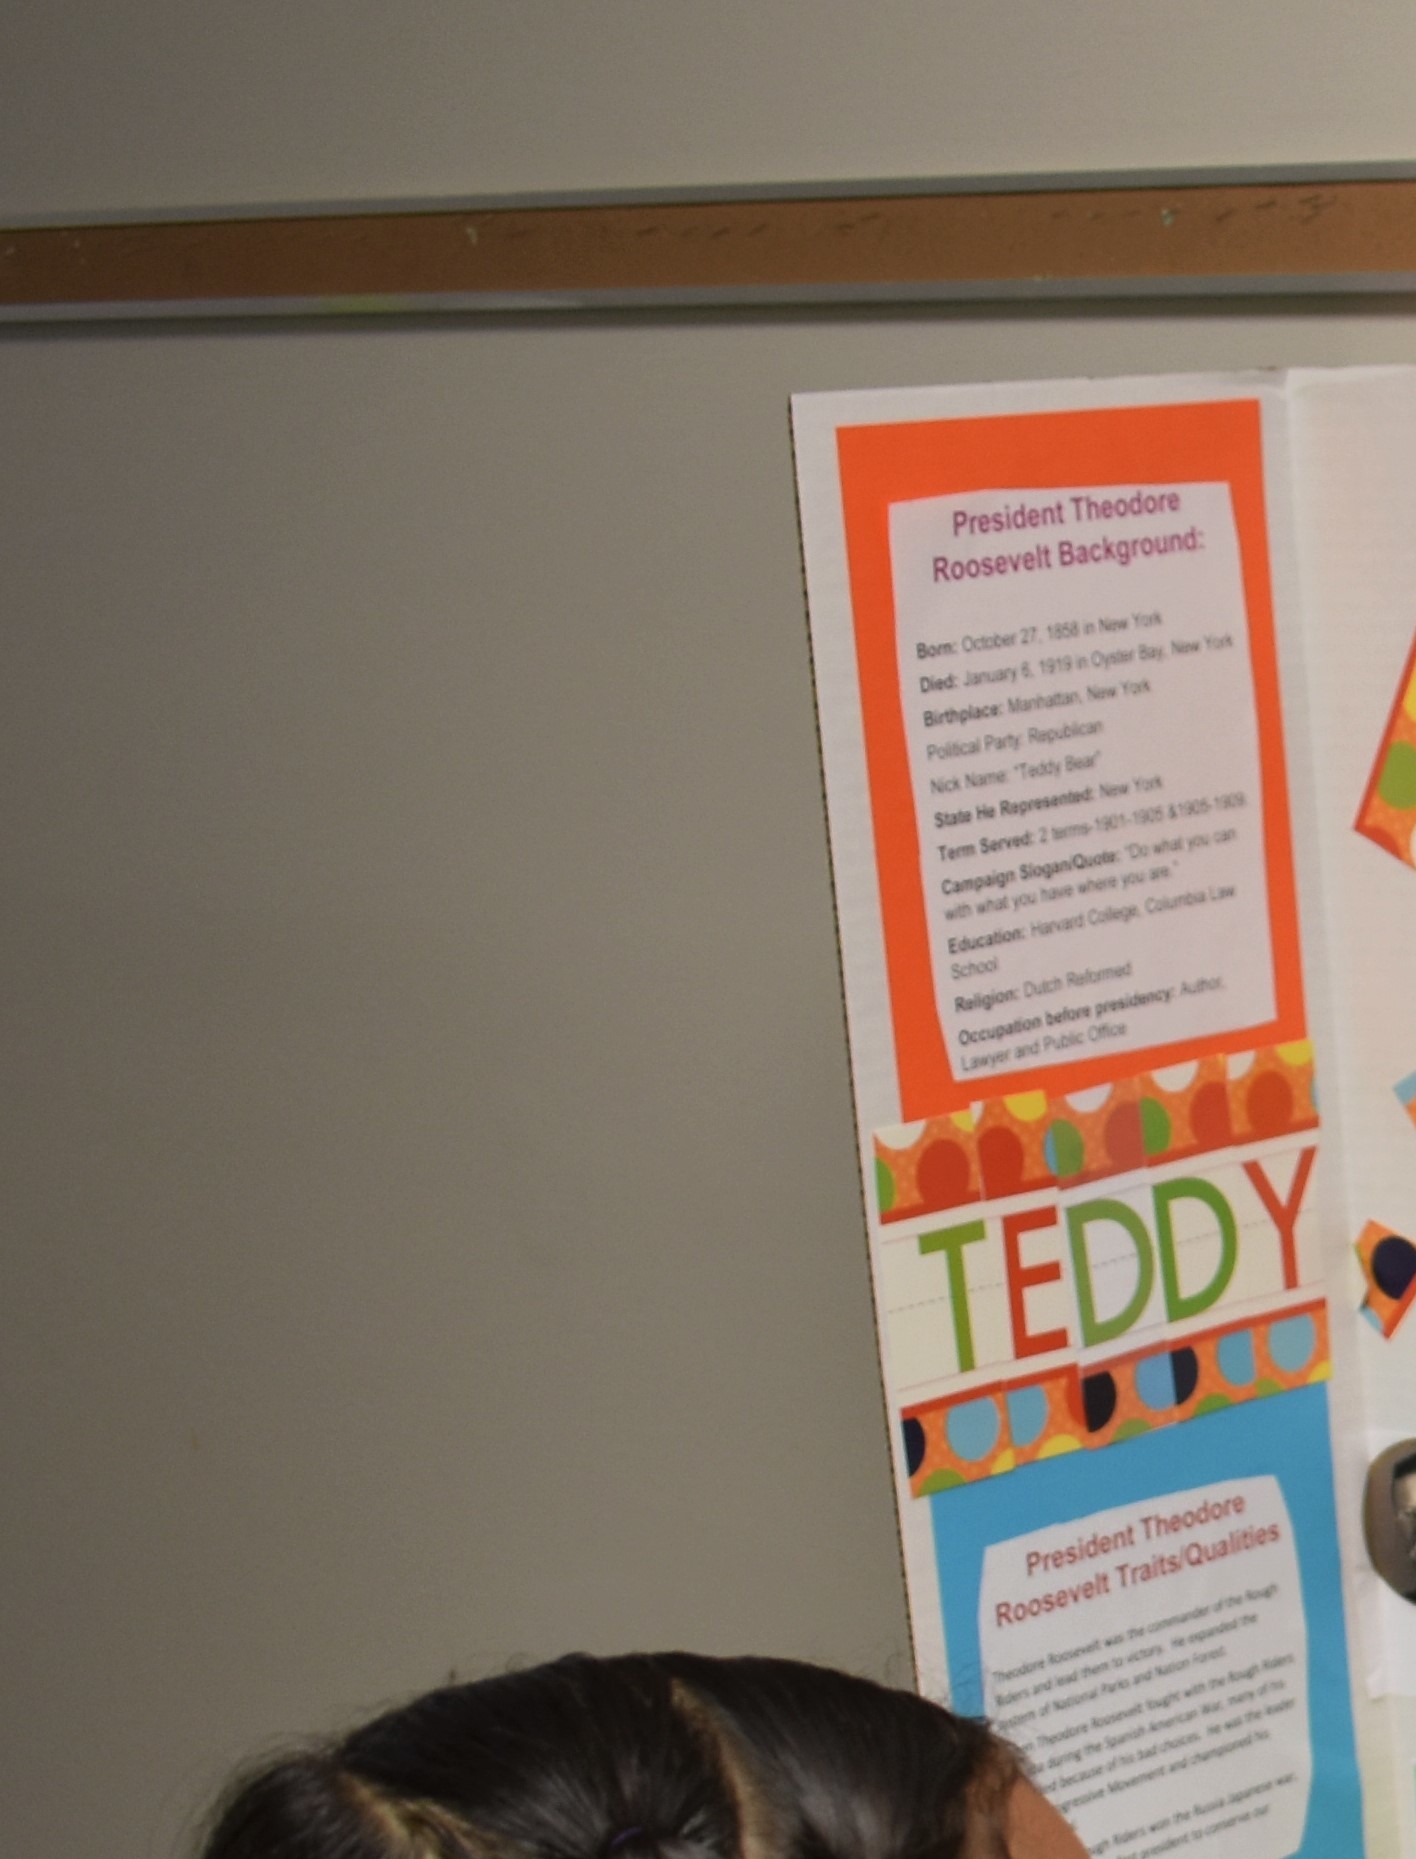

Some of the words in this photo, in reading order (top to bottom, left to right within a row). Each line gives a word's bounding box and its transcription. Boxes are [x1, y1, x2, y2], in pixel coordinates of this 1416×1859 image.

[952, 500, 1064, 535] President
[1070, 491, 1180, 522] Theodore
[932, 543, 1052, 582] Roosevelt
[1058, 526, 1204, 566] Background:
[916, 641, 956, 658] Born:
[962, 631, 1014, 652] October
[1084, 619, 1094, 635] in
[1098, 617, 1126, 633] New
[1132, 609, 1162, 627] York
[920, 673, 956, 694] Died:
[964, 667, 1016, 685] January
[1076, 654, 1088, 670] in
[1090, 649, 1132, 669] Oyster
[1170, 640, 1200, 656] New
[1204, 631, 1232, 651] York
[922, 703, 1002, 725] Birthplace:
[1086, 686, 1116, 701] New
[1120, 677, 1150, 696] York
[926, 737, 978, 761] Political
[1026, 720, 1102, 742] Republican
[930, 775, 960, 795] Nick
[934, 809, 970, 828] State
[976, 805, 994, 821] He
[1000, 786, 1094, 814] Represented:
[1098, 783, 1128, 799] New
[1134, 774, 1162, 792] York
[938, 844, 974, 861] Term
[980, 831, 1030, 854] Served:
[940, 870, 1014, 893] Campaign
[944, 902, 972, 921] with
[976, 895, 1008, 914] what
[1040, 885, 1072, 902] have
[1076, 876, 1116, 894] where
[946, 928, 1024, 955] Education:
[1028, 912, 1082, 937] Harvard
[1144, 889, 1206, 914] Columbia
[1210, 884, 1236, 899] Law
[950, 955, 998, 980] School
[954, 988, 1016, 1011] Religion:
[1022, 974, 1062, 997] Dutch
[1066, 960, 1132, 988] Reformed
[958, 1018, 1040, 1044] Occupation
[1044, 1006, 1088, 1026] before
[962, 1049, 1008, 1069] Lawyer
[1014, 1040, 1038, 1058] and
[1042, 1030, 1082, 1052] Public
[1086, 1022, 1126, 1042] Office
[917, 1145, 1318, 1373] TEDDY
[1026, 1521, 1134, 1576] President
[1140, 1494, 1246, 1542] Theodore
[994, 1569, 1110, 1628] Roosevelt
[1116, 1521, 1280, 1589] Traits/Qualities
